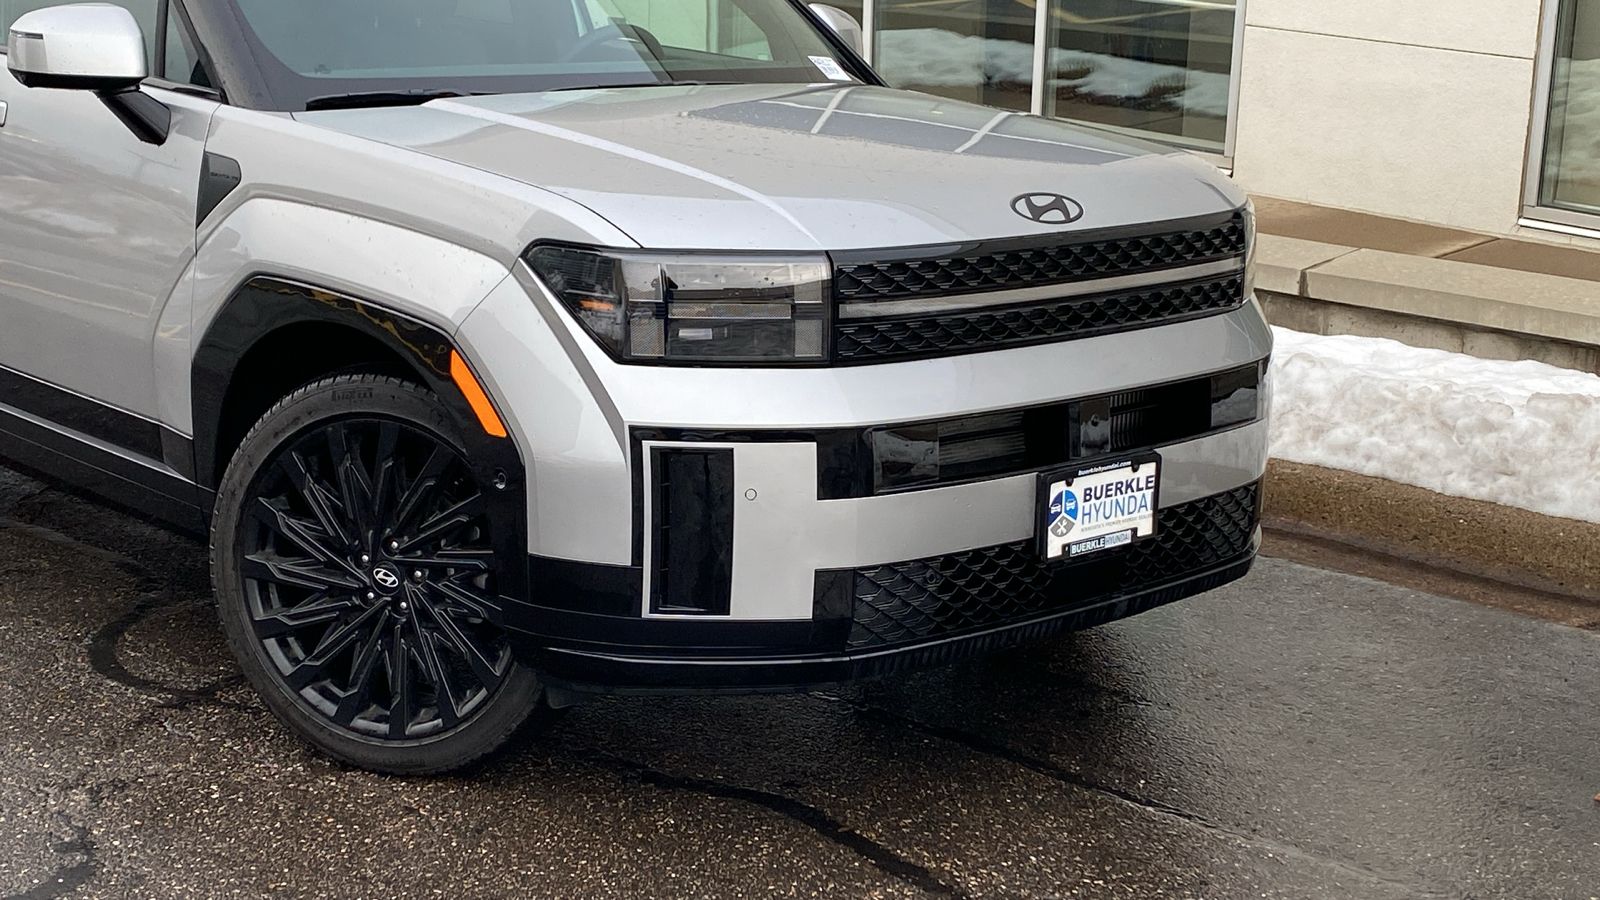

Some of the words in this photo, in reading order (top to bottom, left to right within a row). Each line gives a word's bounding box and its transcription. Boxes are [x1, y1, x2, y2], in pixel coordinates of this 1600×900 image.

[1083, 475, 1155, 503] BUERKLE
[1081, 492, 1154, 525] HYUNDAI
[1071, 538, 1105, 554] BUERKLE
[1105, 532, 1130, 546] HYUNDAI
